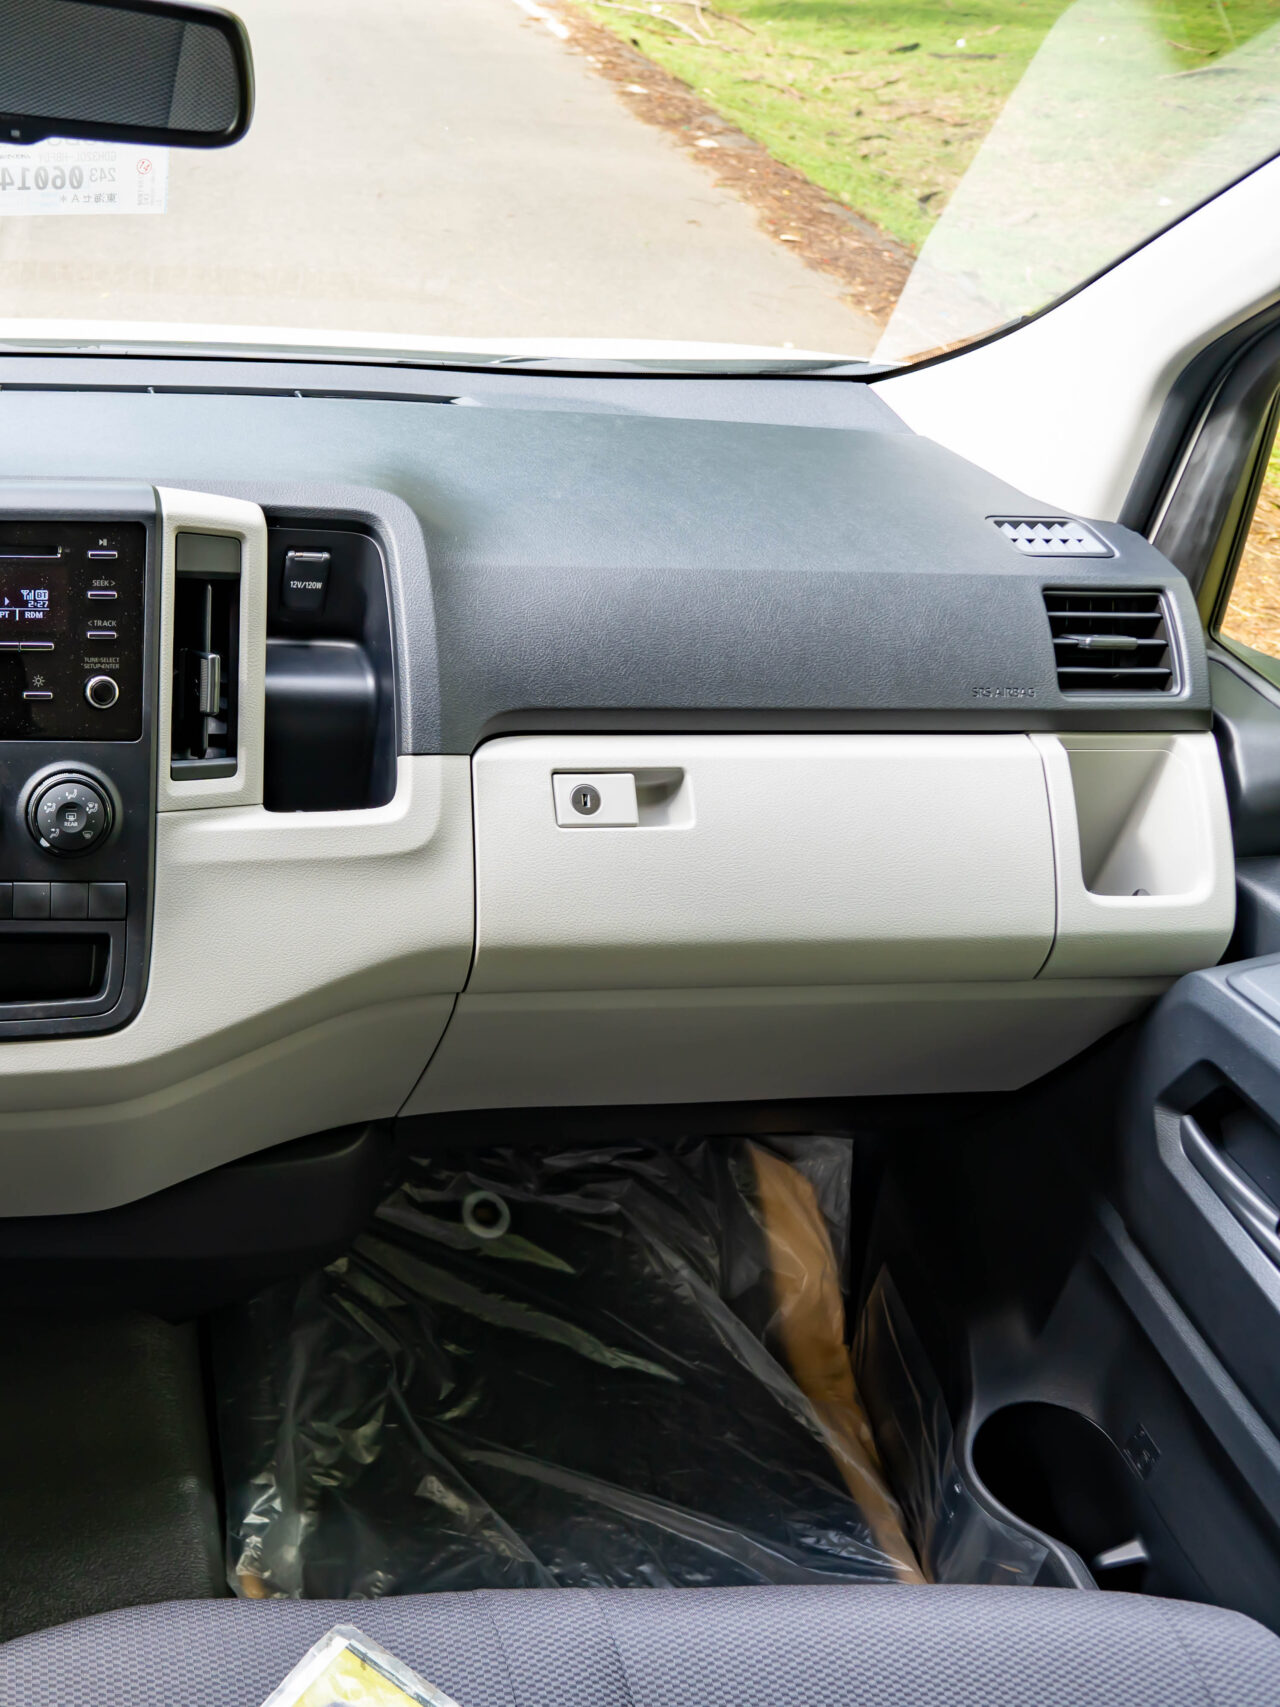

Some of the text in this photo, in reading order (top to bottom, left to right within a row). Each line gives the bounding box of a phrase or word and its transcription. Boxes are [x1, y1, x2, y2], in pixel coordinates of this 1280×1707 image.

[92, 579, 110, 587] SEEK
[290, 580, 323, 590] 12V/120W
[24, 611, 44, 619] RDM
[971, 687, 1036, 698] SRS AIRBAG
